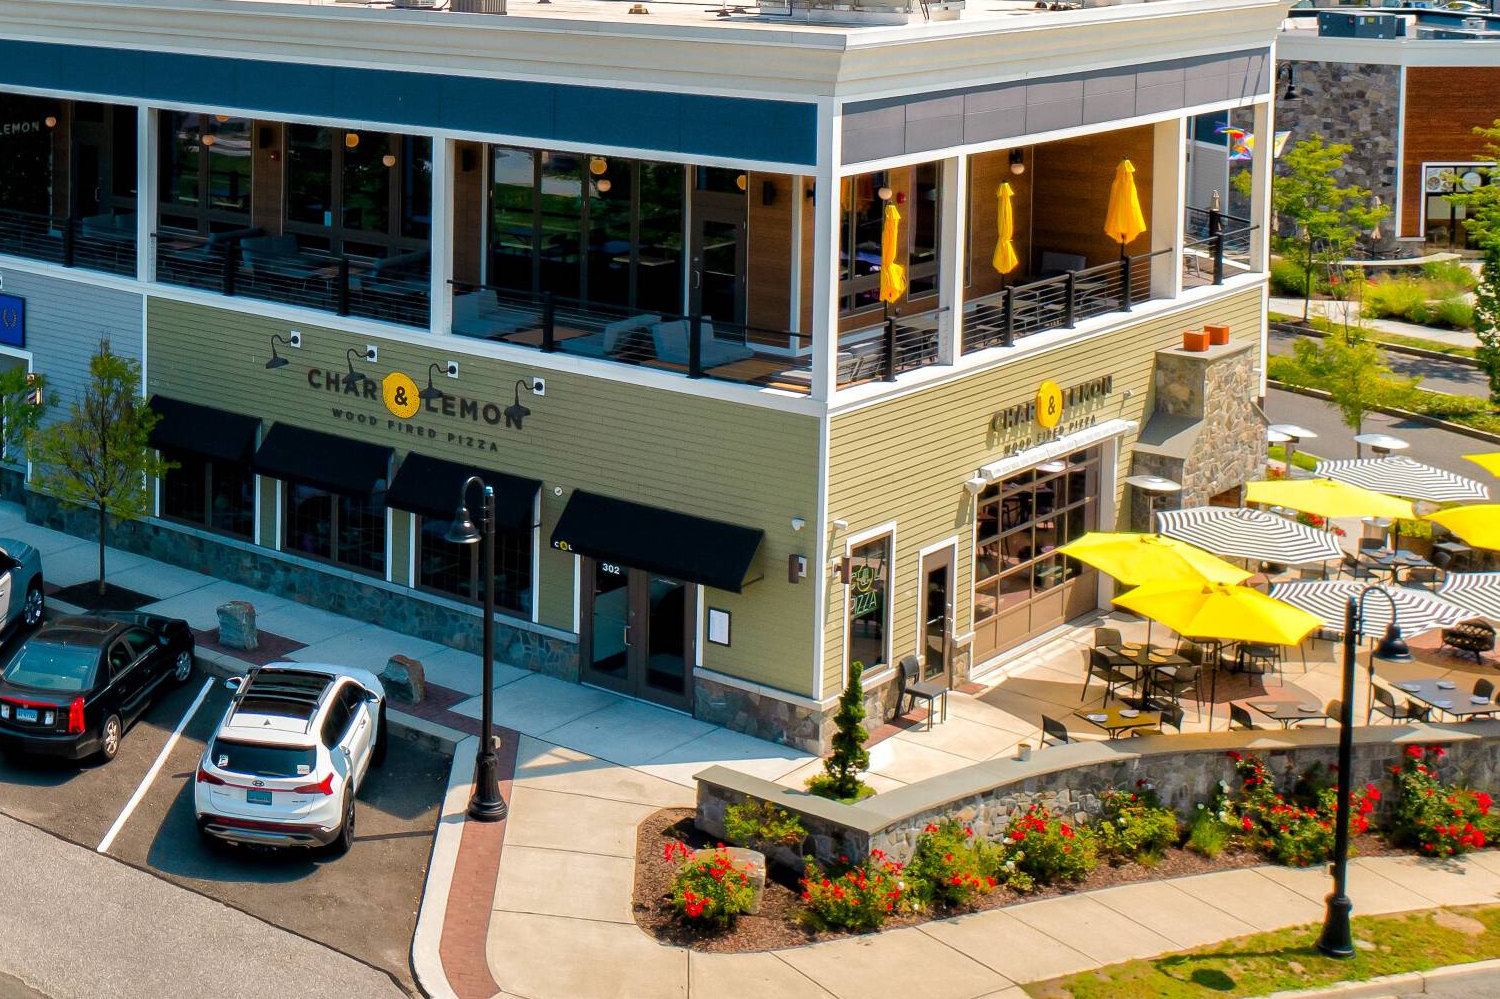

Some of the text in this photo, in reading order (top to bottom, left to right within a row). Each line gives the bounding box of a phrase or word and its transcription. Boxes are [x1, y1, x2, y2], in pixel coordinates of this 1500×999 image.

[308, 368, 523, 430] CHAR & LEMON
[1047, 396, 1056, 416] &
[332, 408, 499, 452] WOOD FIRED PIZZA
[1004, 436, 1032, 455] WOOD
[1069, 414, 1096, 432] PIZZA
[602, 562, 620, 575] 302
